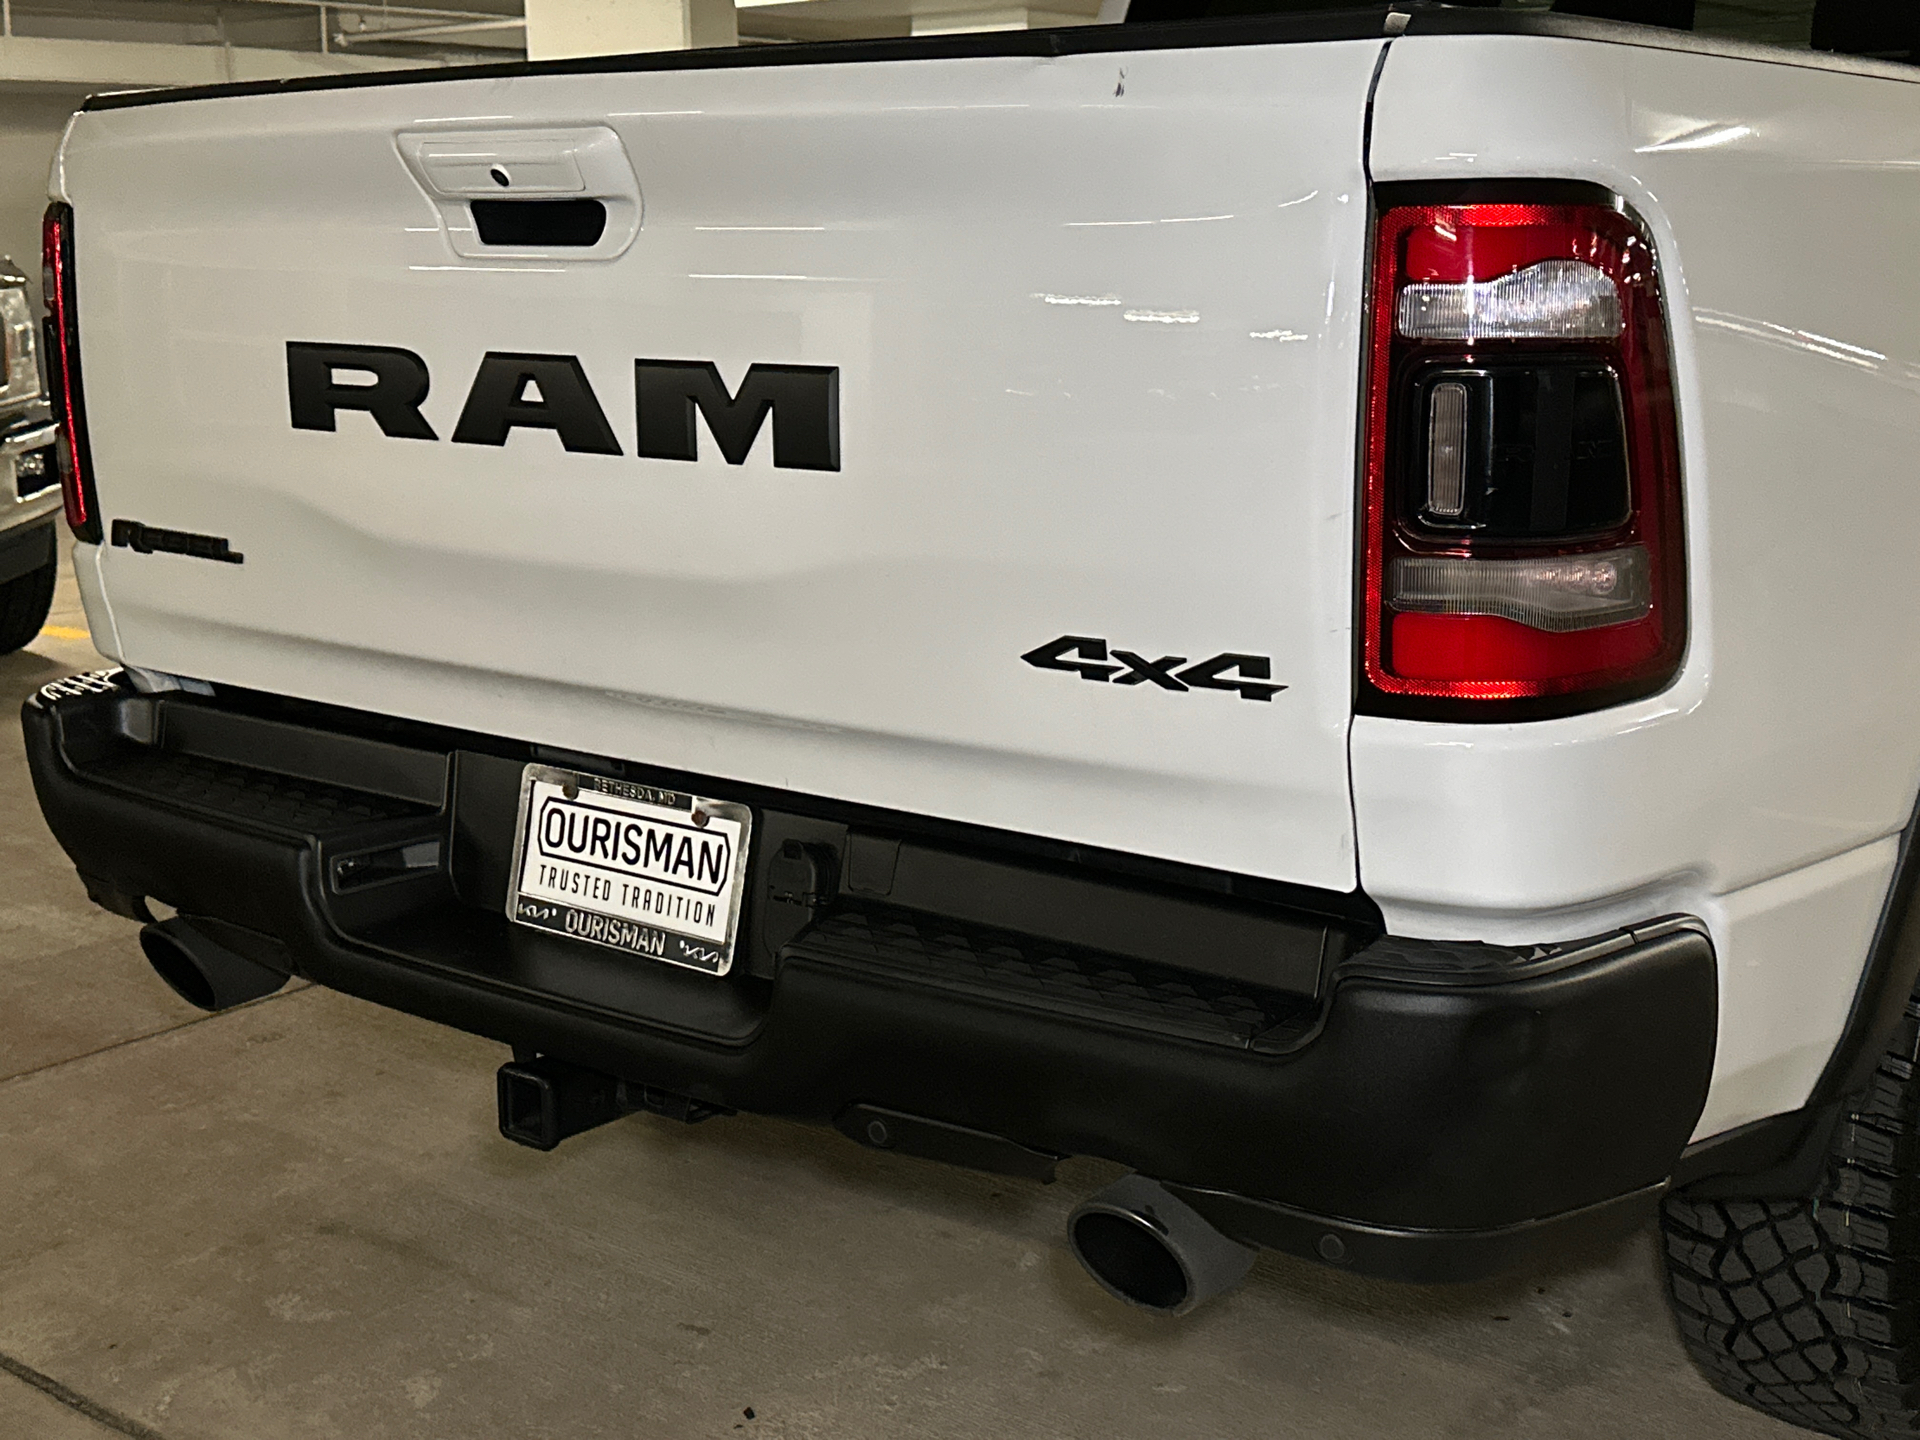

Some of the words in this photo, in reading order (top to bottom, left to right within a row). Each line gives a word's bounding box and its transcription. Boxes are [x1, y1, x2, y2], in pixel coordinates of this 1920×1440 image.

[286, 340, 841, 472] RAM
[658, 791, 677, 807] MD
[543, 806, 724, 884] OURISMAN
[538, 863, 612, 902] TRUSTED
[622, 883, 716, 928] TRADITION
[564, 908, 667, 956] OURISMAN
